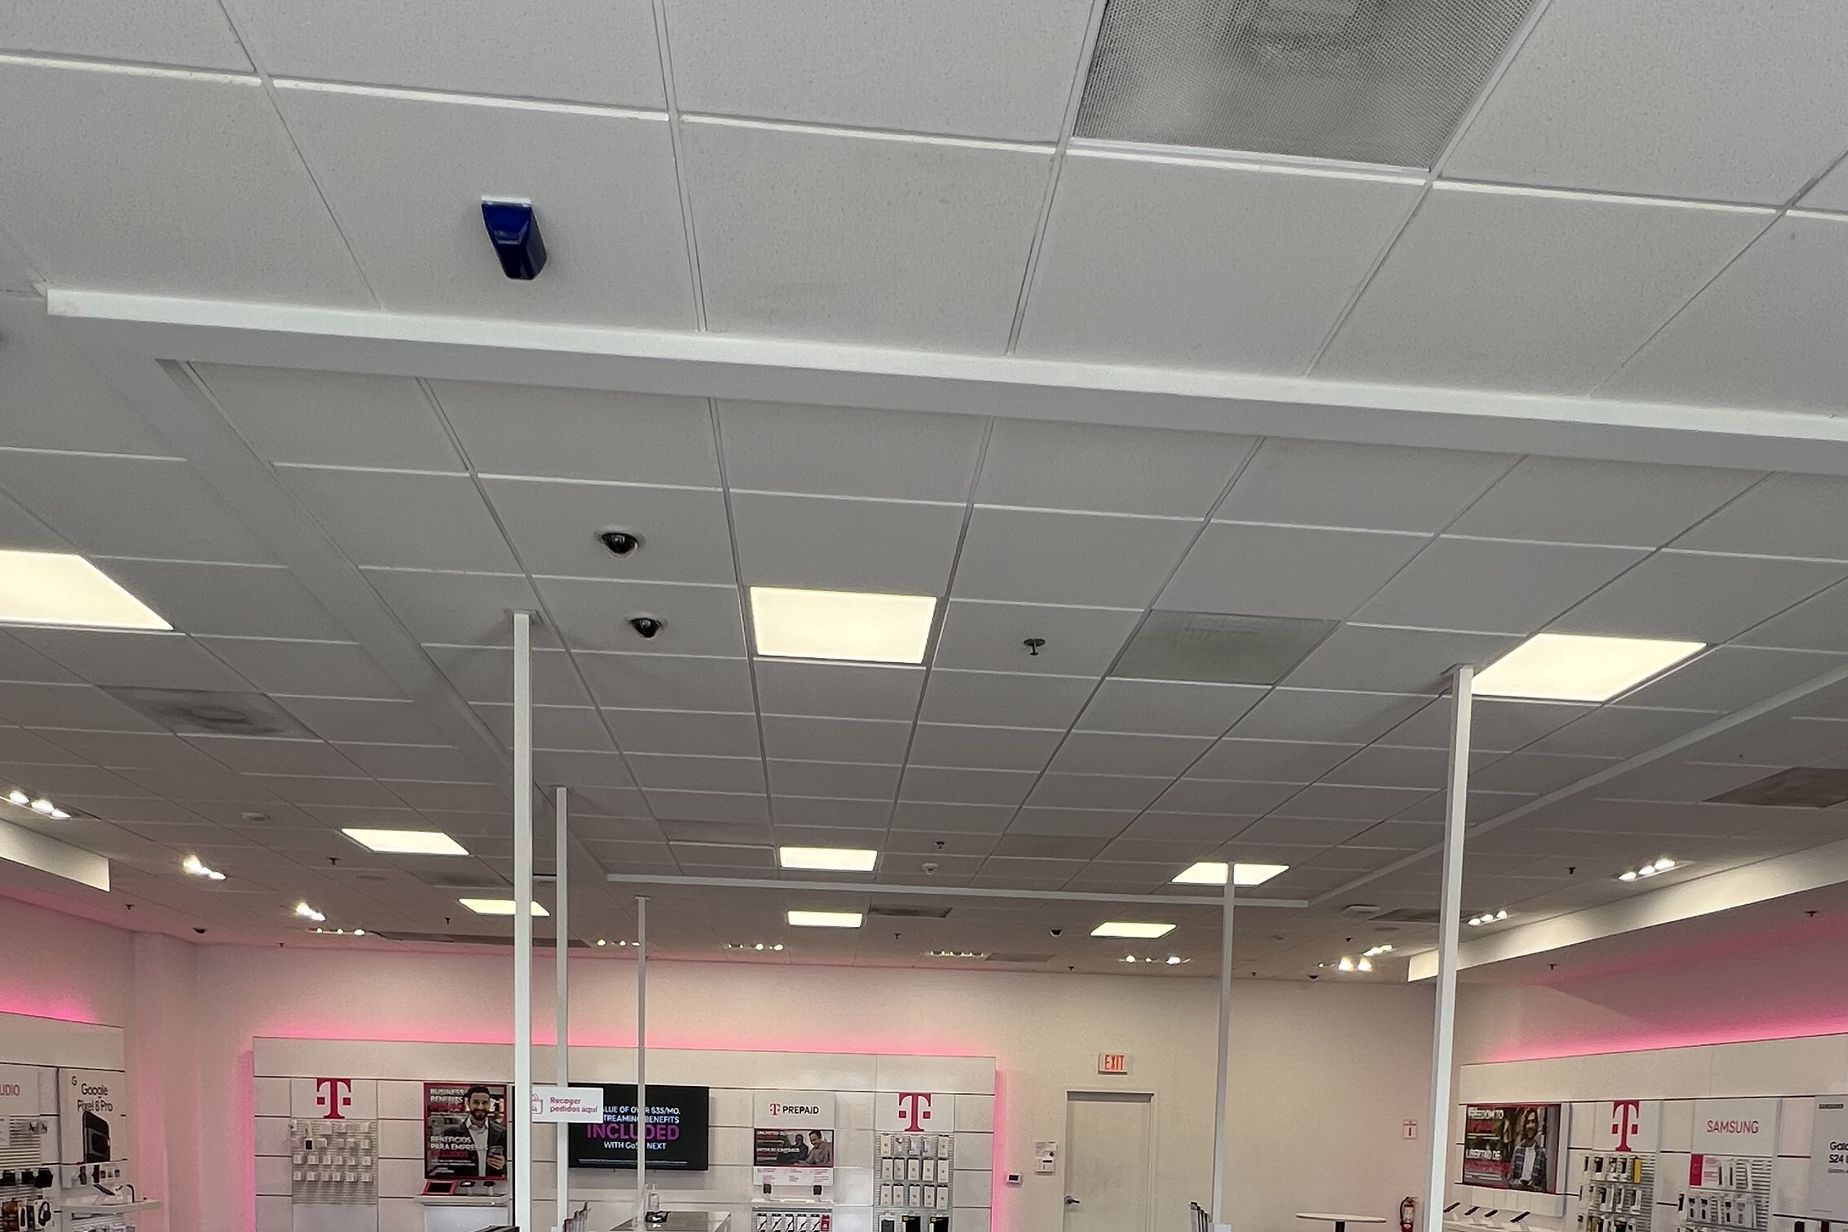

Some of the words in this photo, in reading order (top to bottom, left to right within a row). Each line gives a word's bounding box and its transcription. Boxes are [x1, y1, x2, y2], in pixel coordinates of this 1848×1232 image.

[1104, 1054, 1125, 1070] EXIT
[0, 1084, 20, 1096] UDIO
[81, 1083, 109, 1099] Google
[77, 1099, 94, 1111] Pixel
[101, 1099, 113, 1111] Pro
[550, 1097, 582, 1106] Recoger
[550, 1105, 580, 1113] pedidos
[581, 1105, 598, 1115] aquí
[630, 1106, 650, 1114] OVR
[782, 1105, 820, 1115] PREPAID
[603, 1114, 639, 1122] TREAMIN
[1706, 1120, 1759, 1134] SAMSUNG
[586, 1124, 680, 1141] INCLUDED
[603, 1141, 624, 1149] WITH
[625, 1141, 640, 1149] Go5
[646, 1142, 667, 1150] NEXT
[1829, 1154, 1844, 1163] S24
